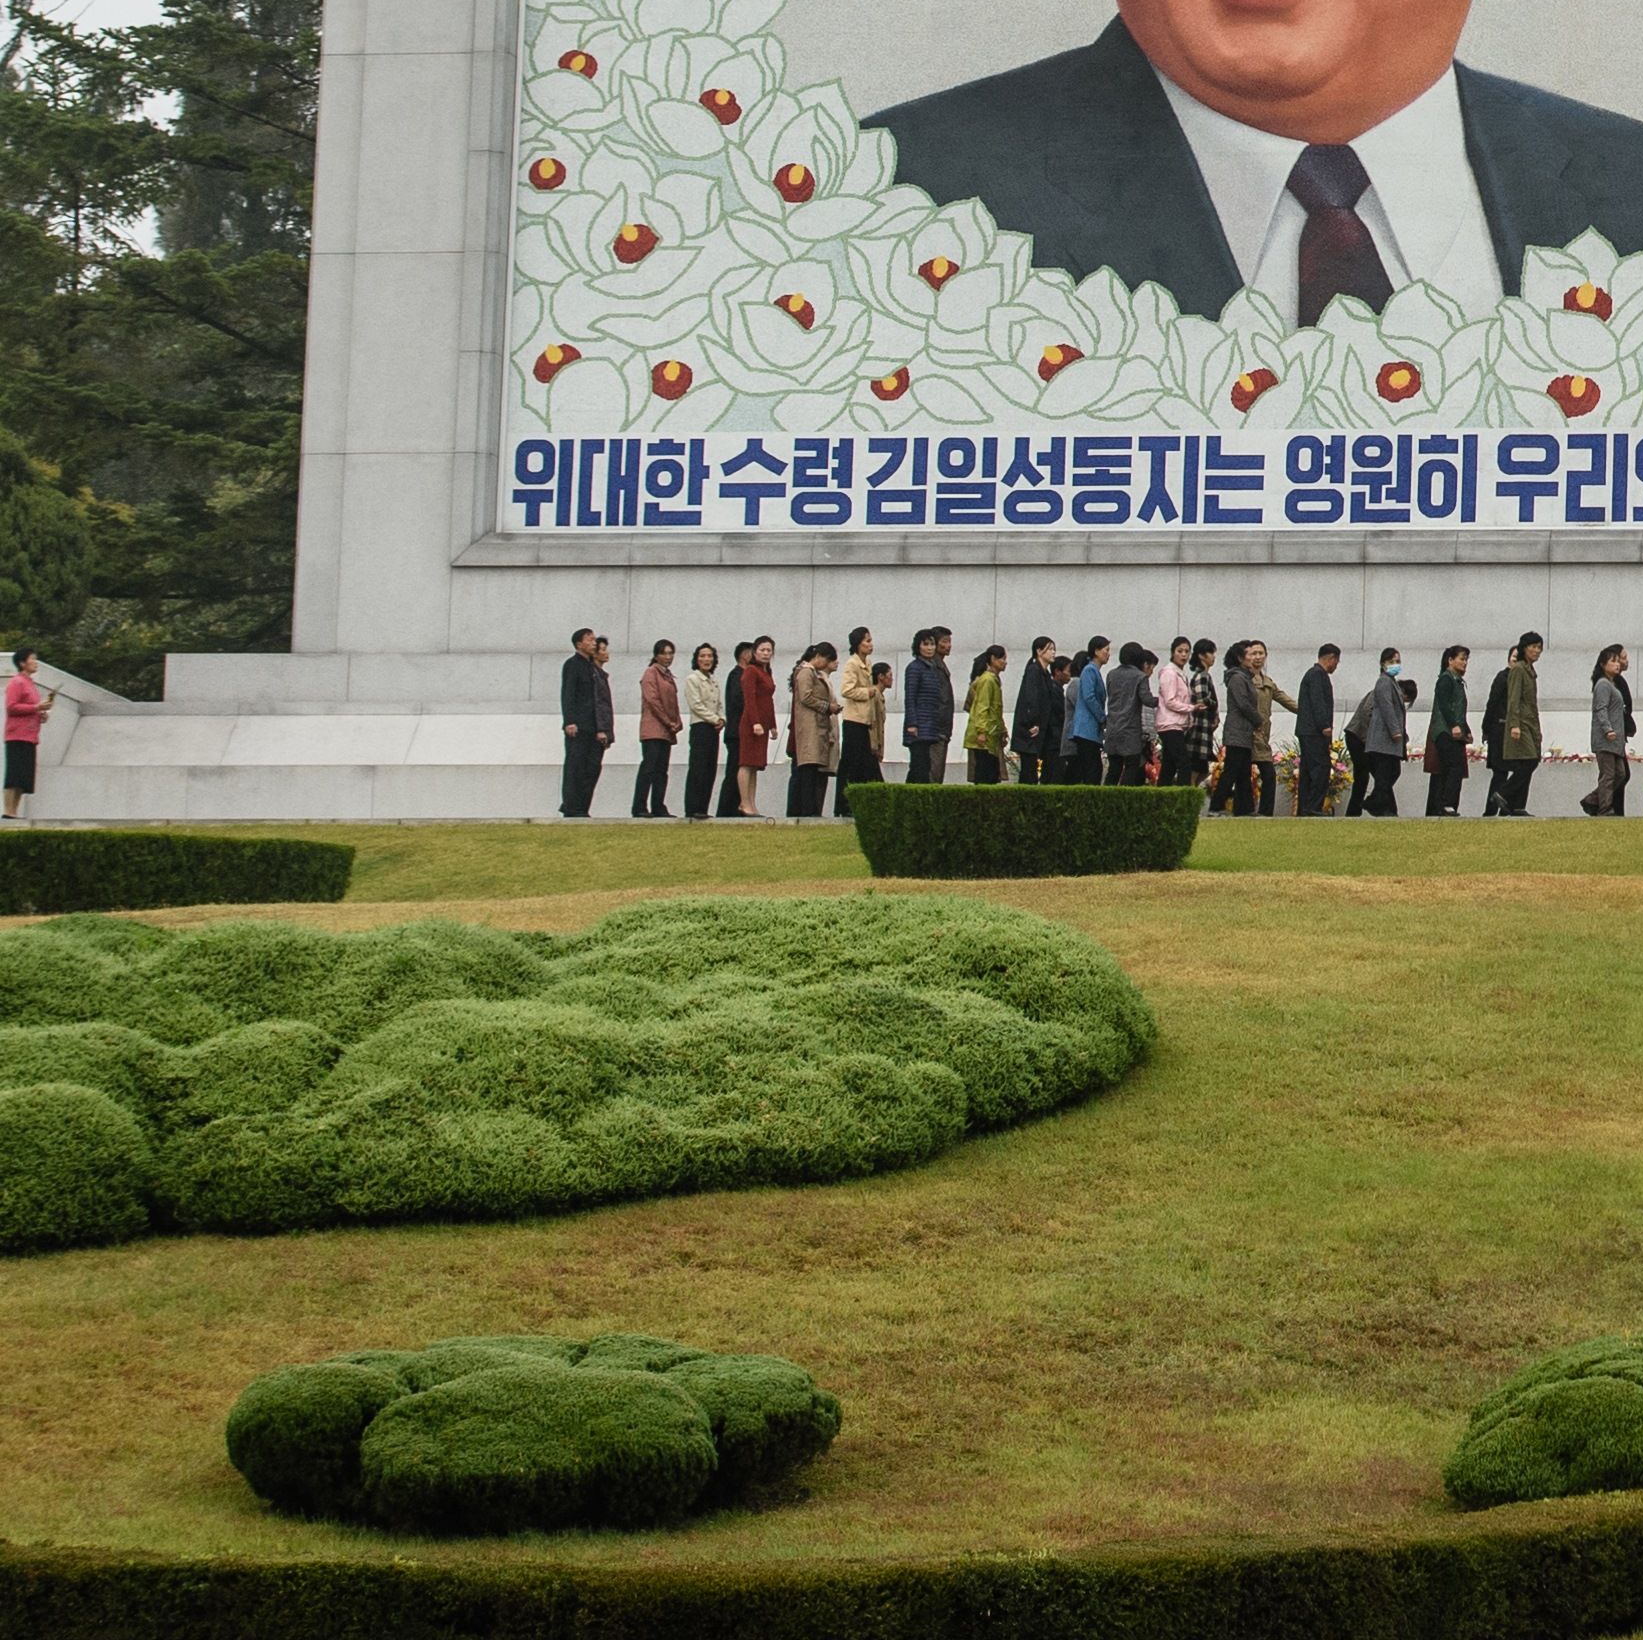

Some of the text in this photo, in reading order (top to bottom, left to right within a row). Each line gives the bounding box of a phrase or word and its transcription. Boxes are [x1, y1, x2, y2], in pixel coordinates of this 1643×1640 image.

[513, 439, 709, 526] 위대한
[719, 438, 854, 525] 수령
[866, 436, 1265, 525] 김일성동지는
[1285, 435, 1478, 523] 영원히
